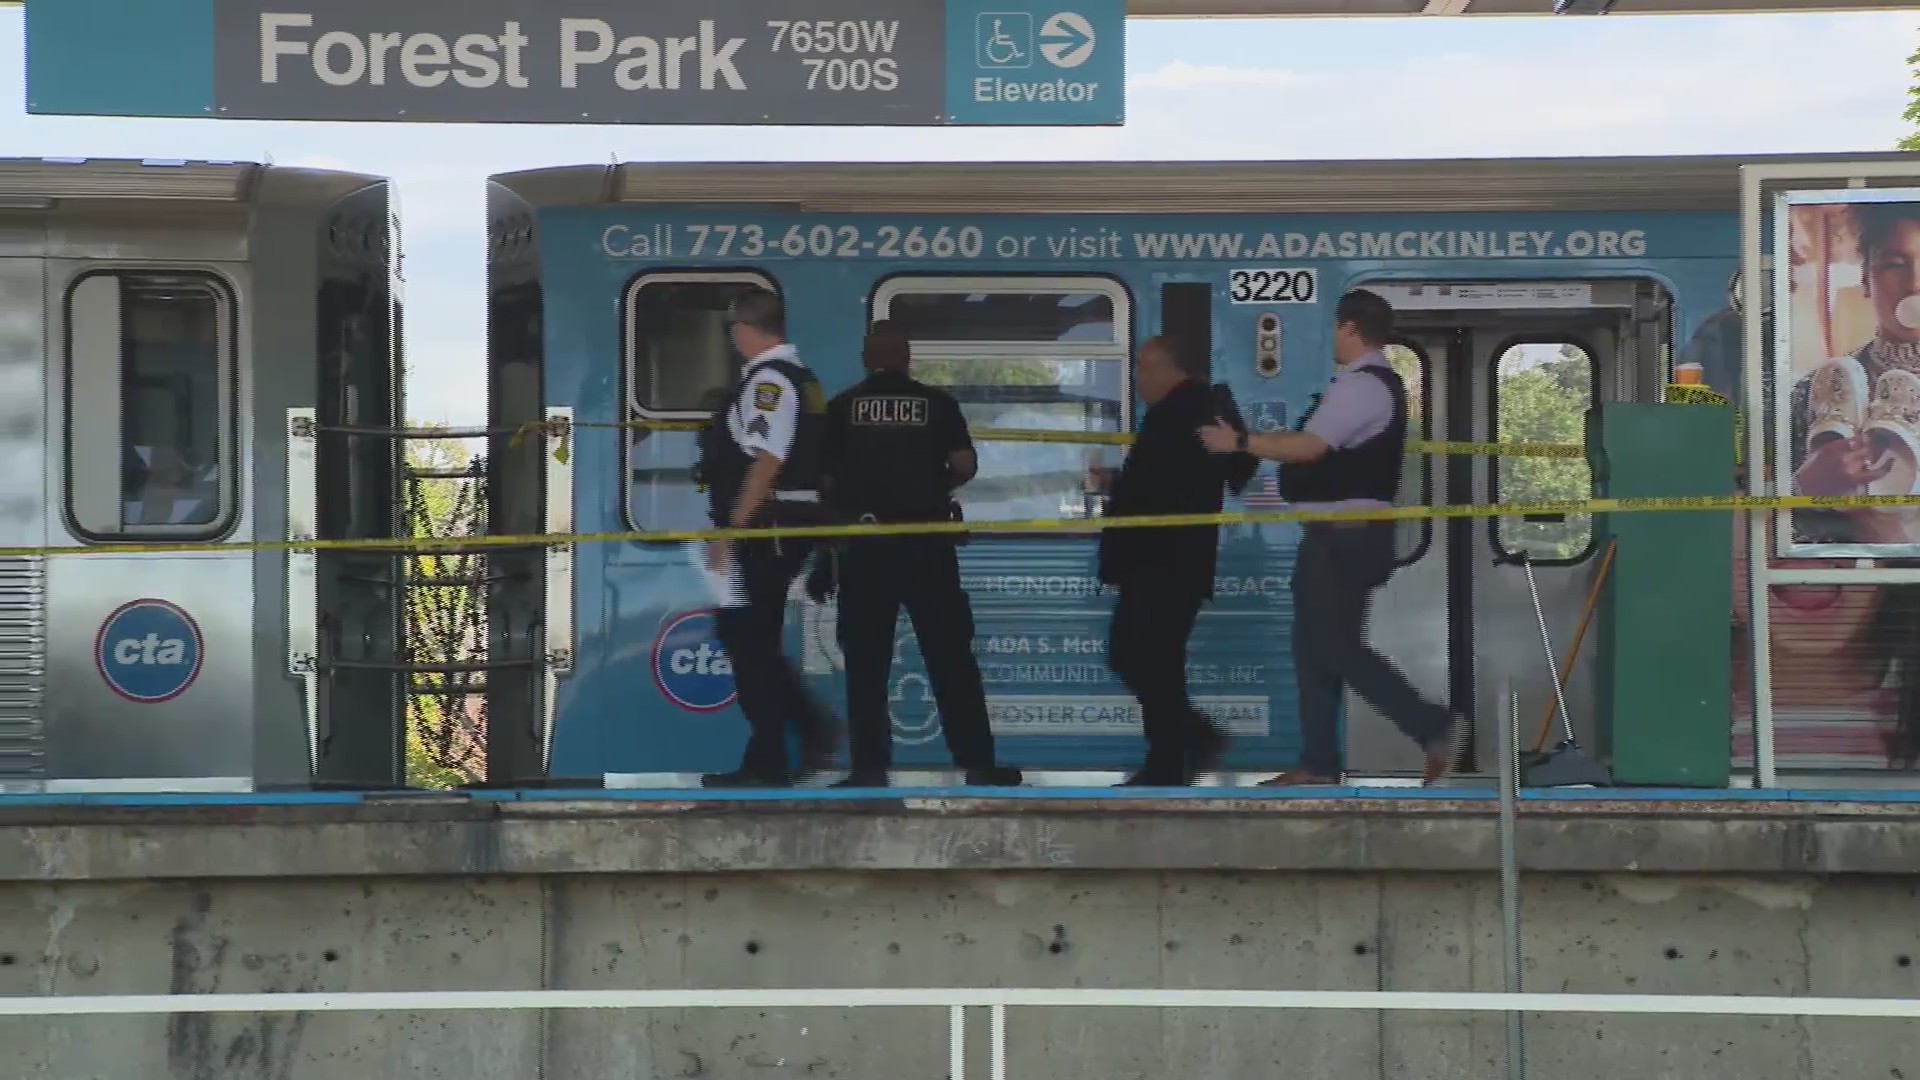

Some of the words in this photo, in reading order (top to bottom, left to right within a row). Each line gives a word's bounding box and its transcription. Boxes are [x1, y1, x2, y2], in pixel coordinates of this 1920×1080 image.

[260, 12, 530, 88] Forest
[560, 18, 748, 90] Park
[767, 20, 900, 52] 7650W
[803, 58, 899, 91] 700S
[974, 77, 1098, 102] Elevator
[601, 224, 673, 257] Call
[685, 225, 984, 258] 773-602-2660
[995, 233, 1037, 258] or
[1047, 227, 1123, 259] visit
[1132, 230, 1647, 258] WWW.ADASMCKINLEY.ORG
[1231, 270, 1314, 303] 3220
[856, 398, 922, 422] POLICE
[114, 632, 186, 665] cta
[986, 636, 1031, 655] ADA
[1037, 636, 1056, 655] S.
[989, 704, 1074, 724] FOSTER
[1080, 704, 1140, 724] CARE
